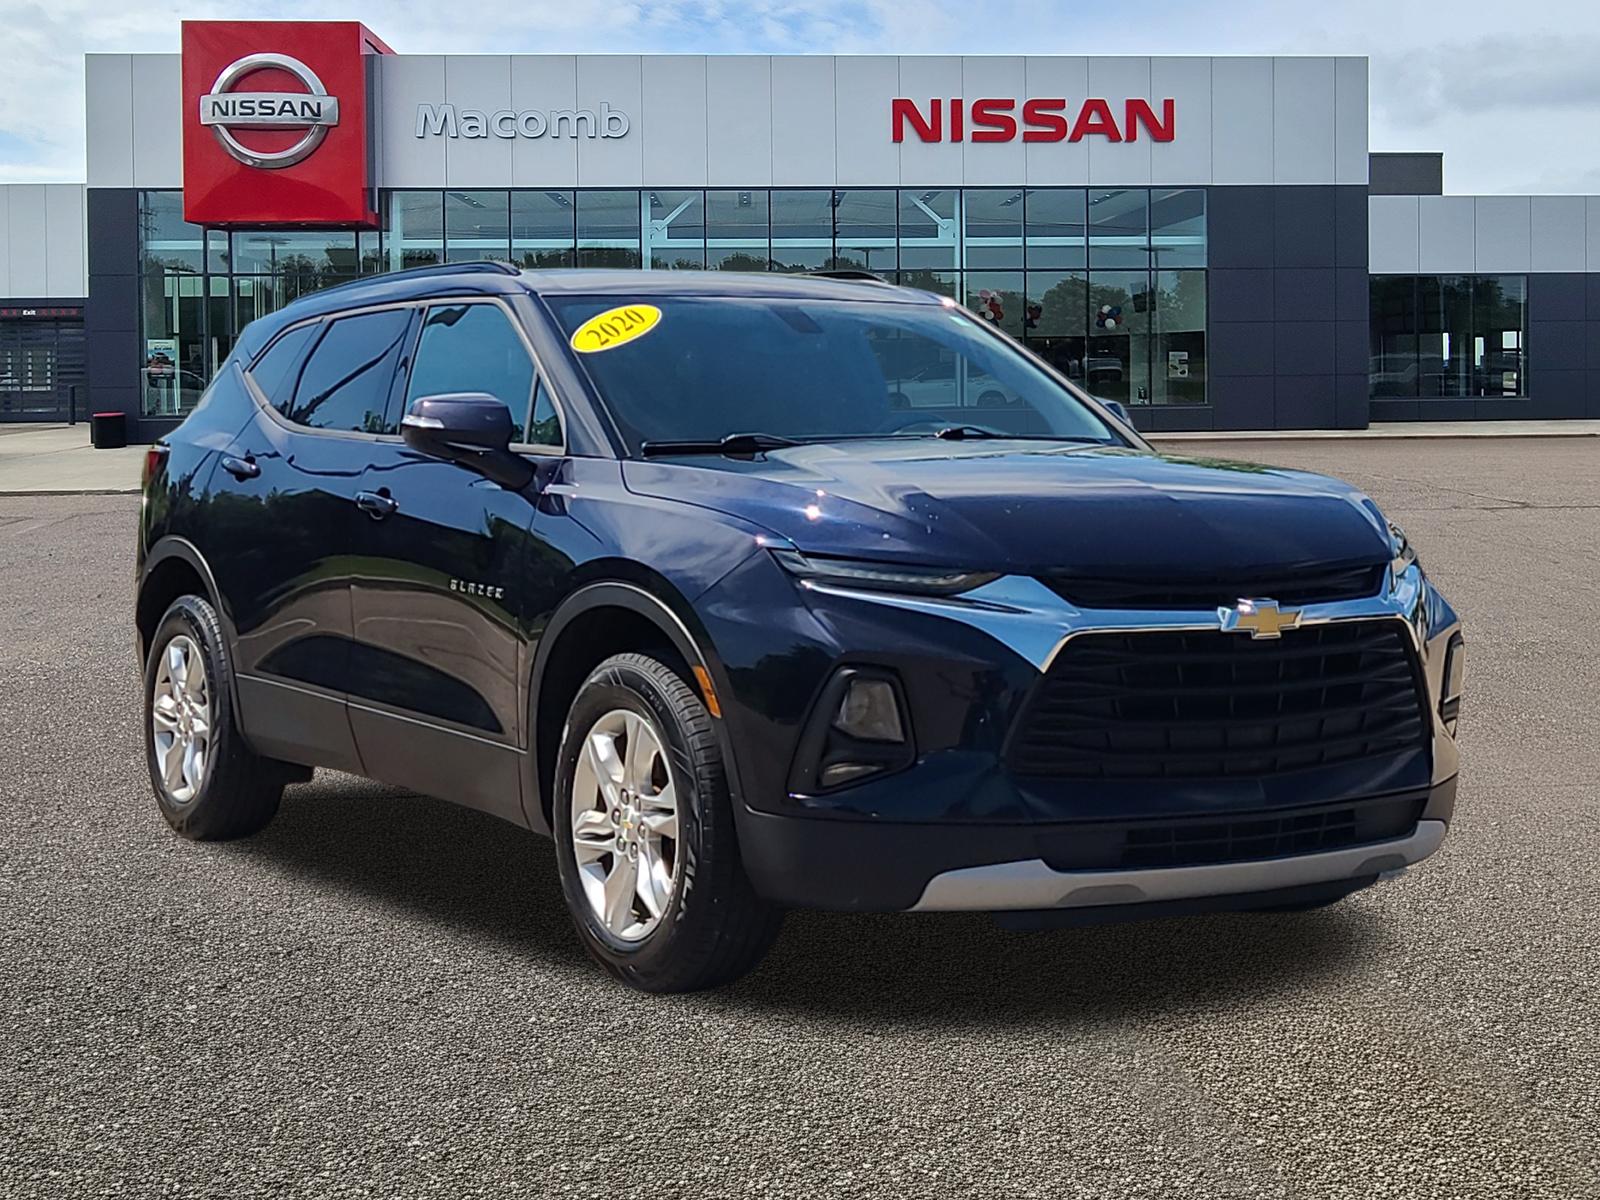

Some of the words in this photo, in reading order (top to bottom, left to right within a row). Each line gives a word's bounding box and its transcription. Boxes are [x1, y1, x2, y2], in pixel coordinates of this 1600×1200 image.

[211, 99, 322, 118] NISSAN
[415, 102, 630, 139] Macomb
[892, 98, 1175, 143] NISSAN
[586, 308, 645, 346] 2020
[449, 579, 504, 599] BLAZER
